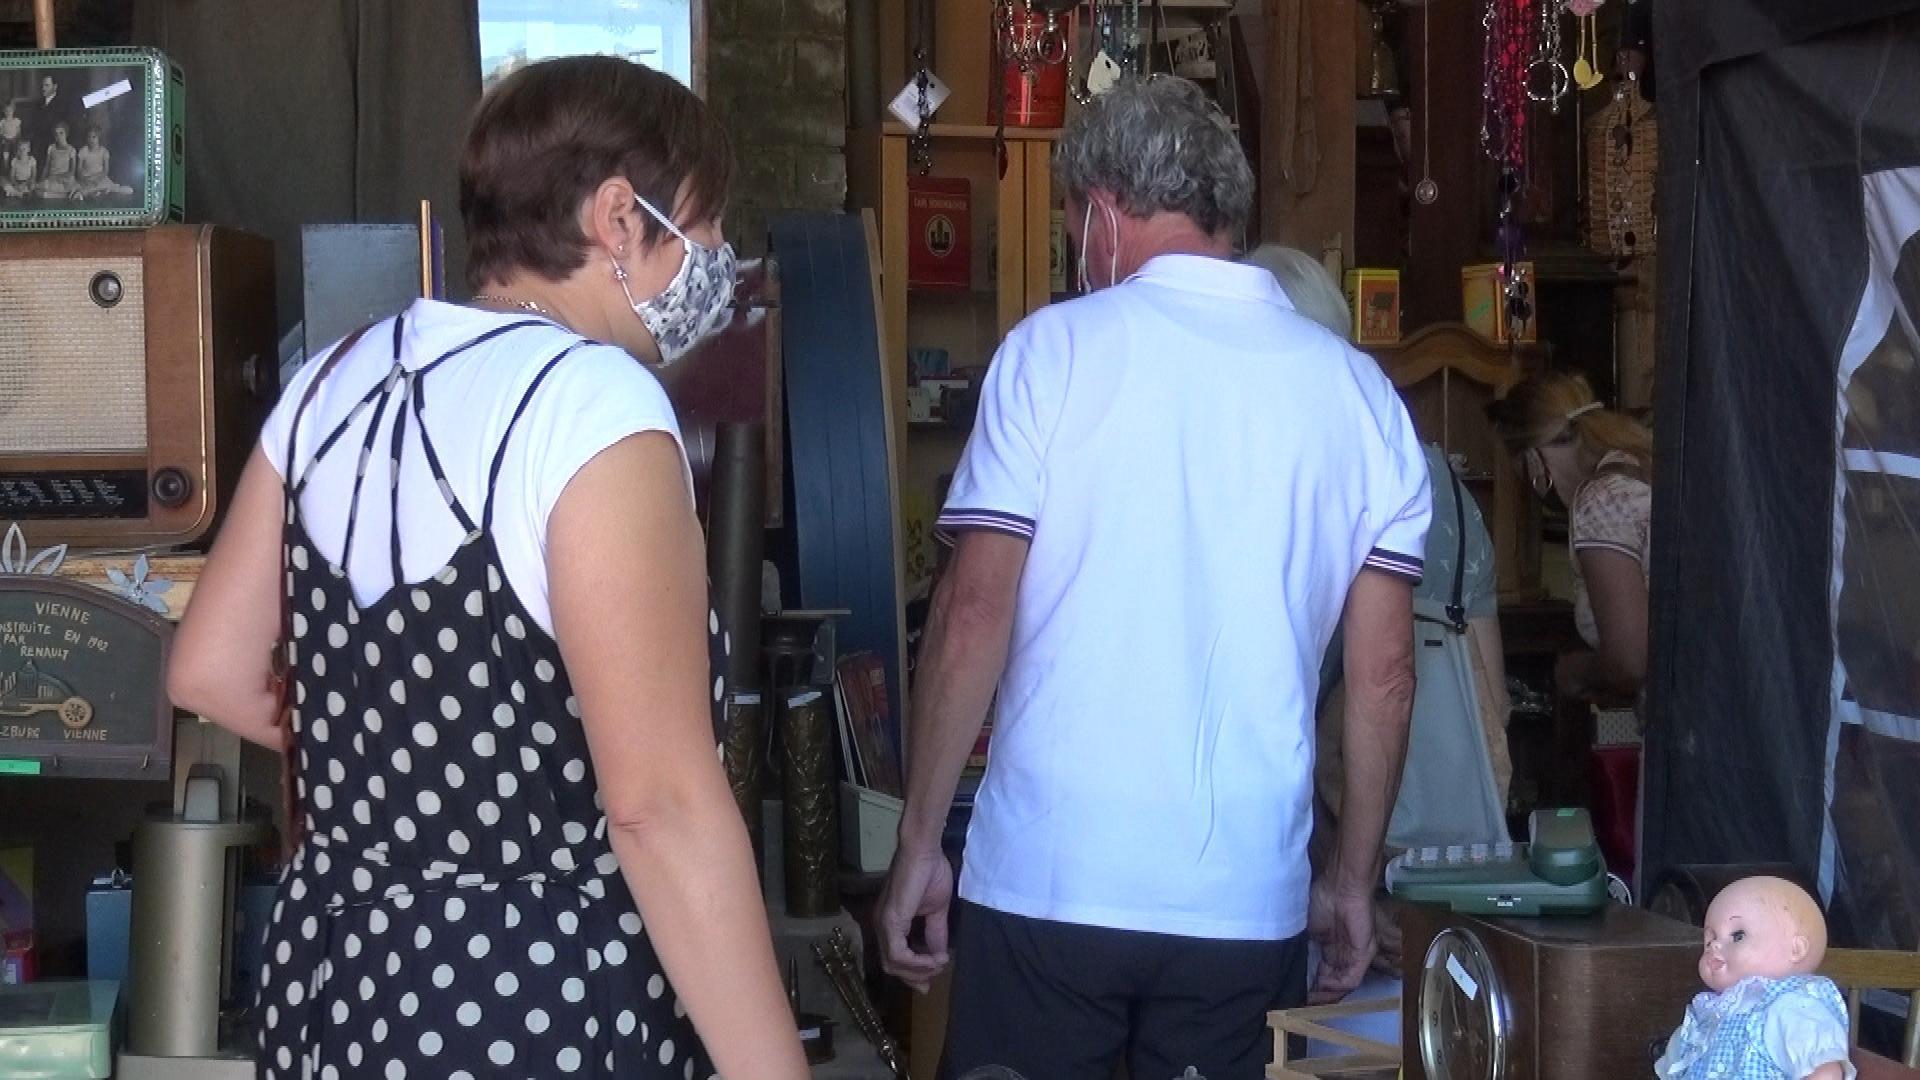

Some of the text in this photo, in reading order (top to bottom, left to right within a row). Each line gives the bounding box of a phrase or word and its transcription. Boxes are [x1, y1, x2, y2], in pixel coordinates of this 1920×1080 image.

[35, 602, 91, 624] VIENNE
[4, 634, 26, 646] PAR
[64, 630, 81, 644] EN
[20, 646, 70, 660] RENAULT
[63, 729, 108, 741] VIENNE
